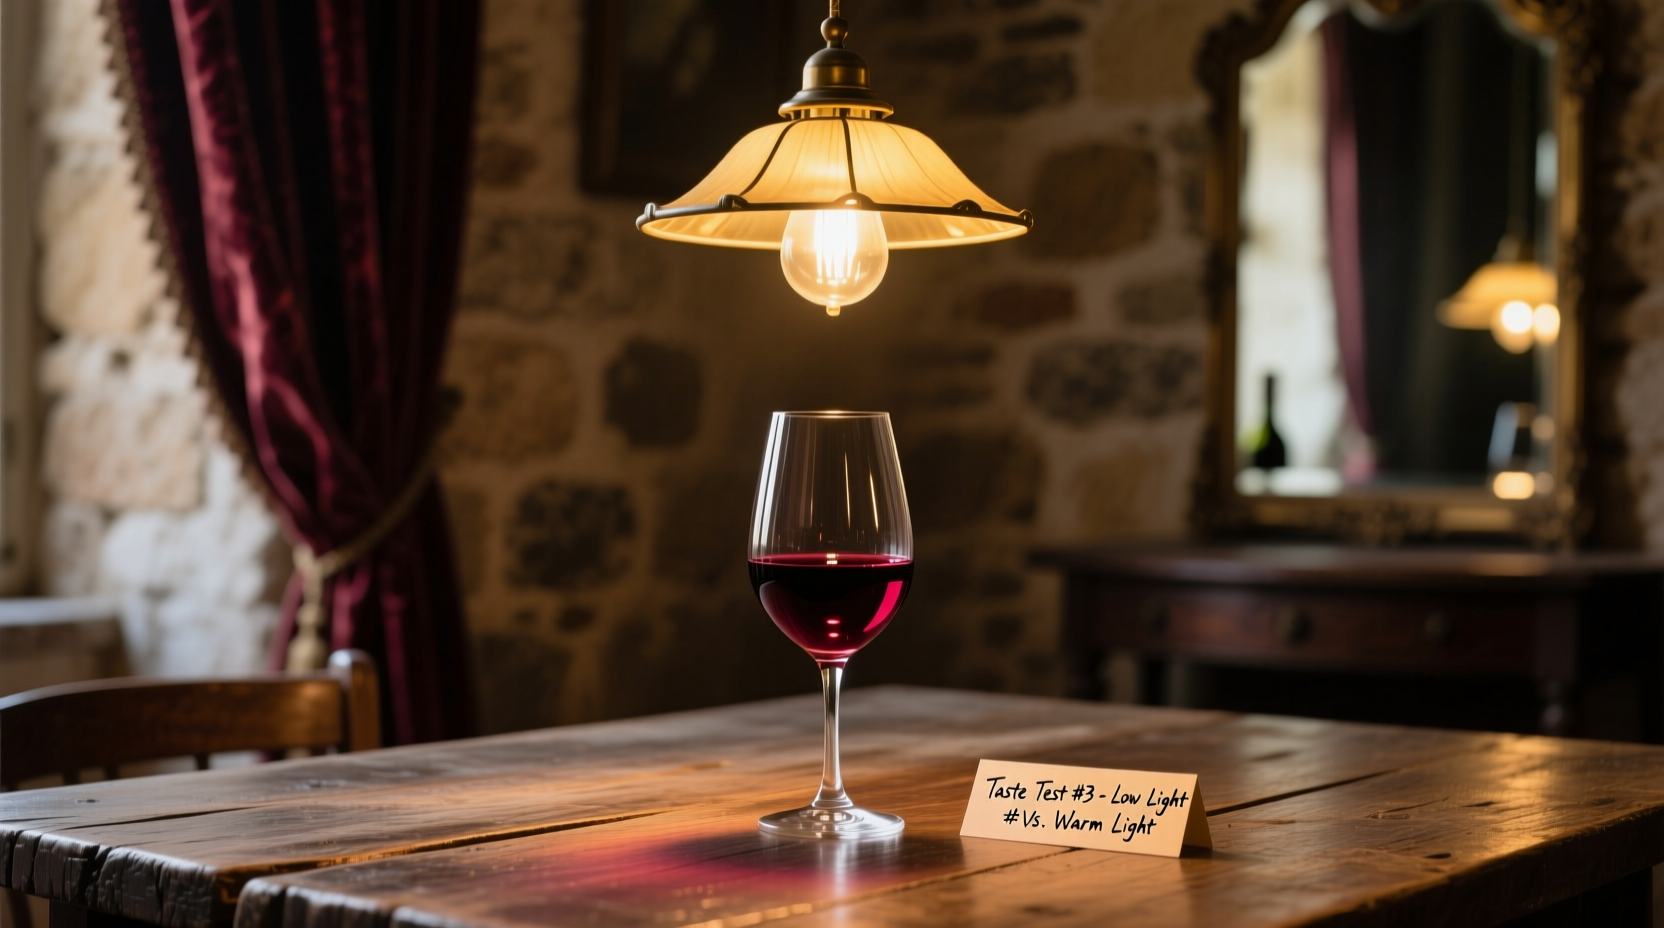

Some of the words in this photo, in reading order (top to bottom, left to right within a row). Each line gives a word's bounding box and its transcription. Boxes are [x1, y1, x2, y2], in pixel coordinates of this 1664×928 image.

[986, 776, 1027, 800] Taste
[1036, 780, 1069, 802] Test
[1071, 784, 1095, 803] #3
[1110, 784, 1142, 805] Low
[1146, 787, 1189, 816] Light
[1055, 810, 1103, 832] Warm
[1111, 812, 1157, 843] Light
